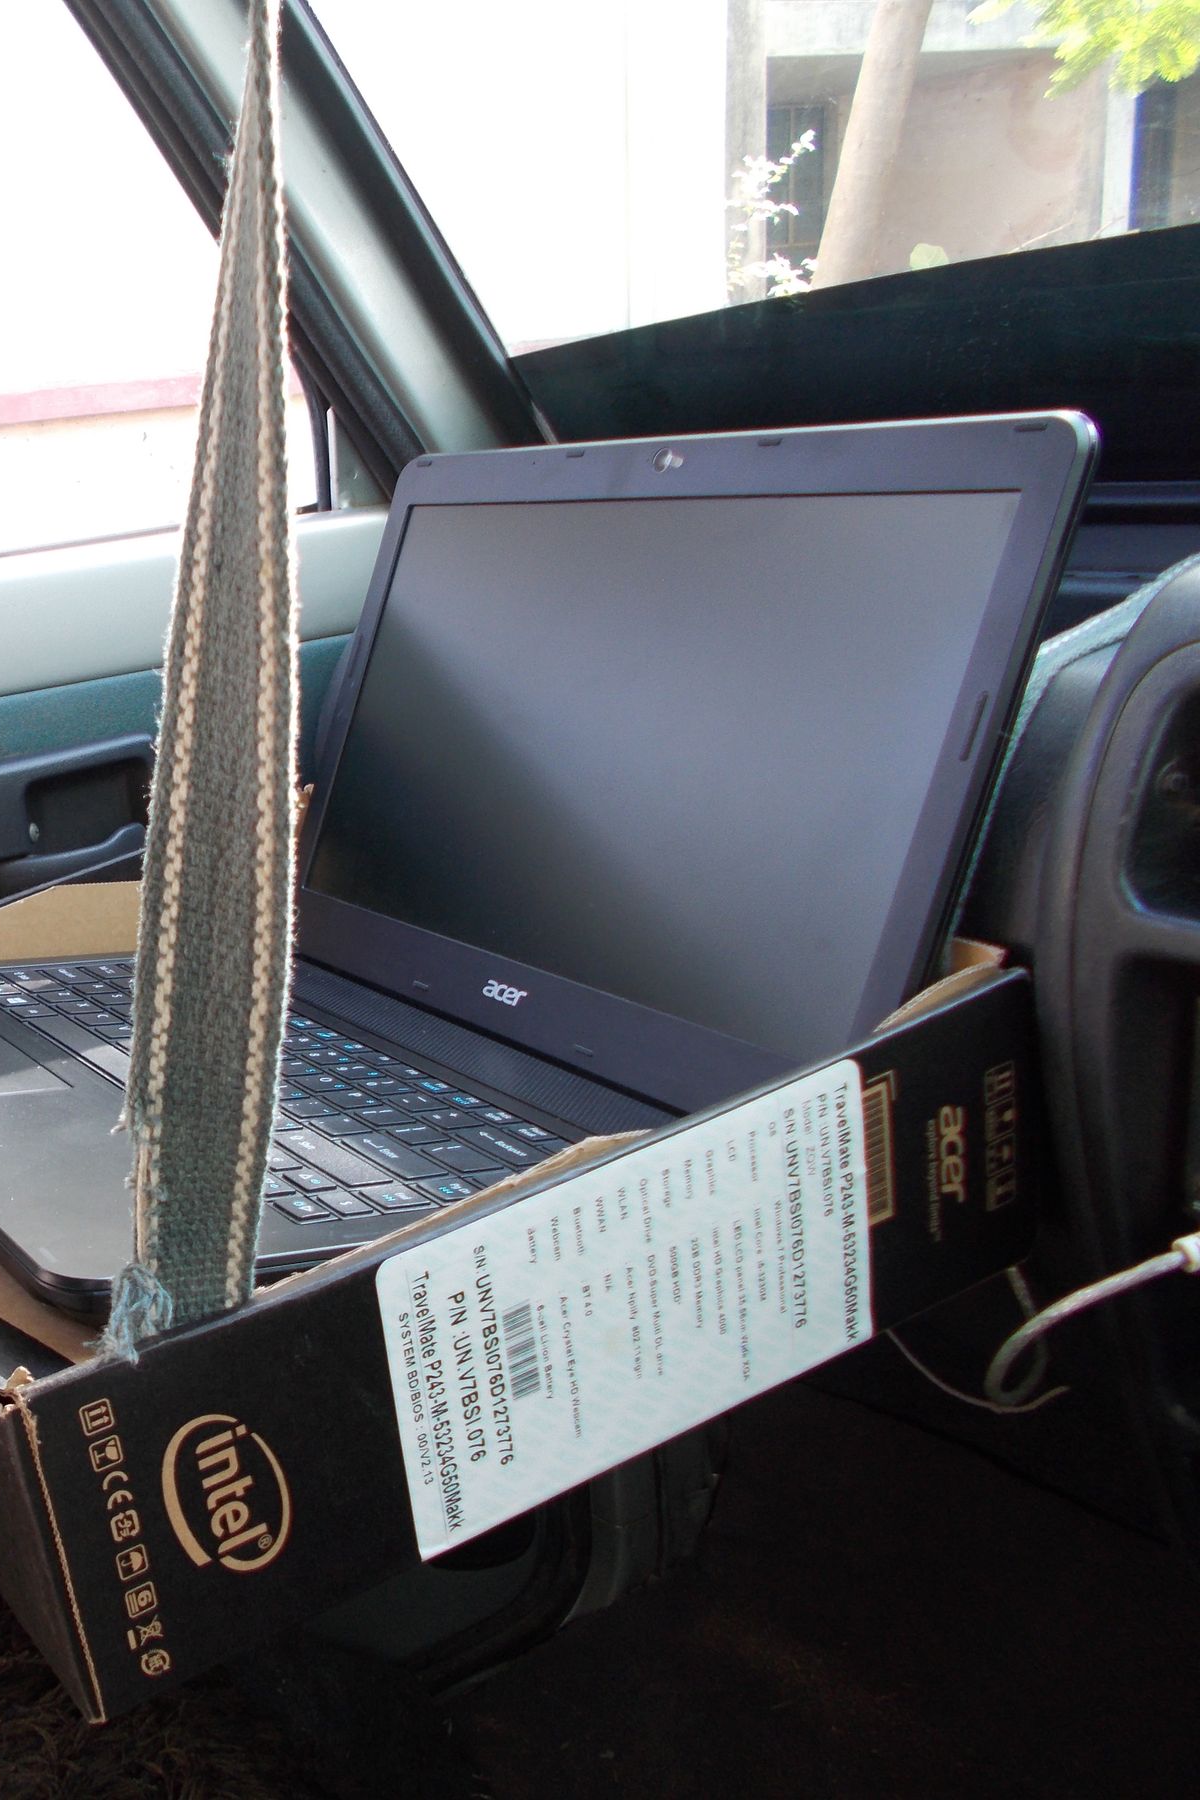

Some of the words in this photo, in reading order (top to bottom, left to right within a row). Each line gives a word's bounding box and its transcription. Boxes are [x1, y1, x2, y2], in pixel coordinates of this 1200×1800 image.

[482, 979, 528, 1007] acer
[816, 1093, 828, 1118] P/N
[834, 1082, 852, 1170] TravelMate
[939, 1105, 965, 1203] acer
[785, 1139, 808, 1329] UNV7BSI076D1273776
[412, 1270, 438, 1359] TravelMate
[447, 1290, 468, 1327] P/N
[398, 1312, 416, 1368] SYSTEM
[407, 1369, 424, 1423] BD/BIOS
[475, 1273, 515, 1466] UNV7BSI076D1273776
[195, 1424, 268, 1554] intel
[424, 1359, 466, 1533] P243-M-53234G50Makk
